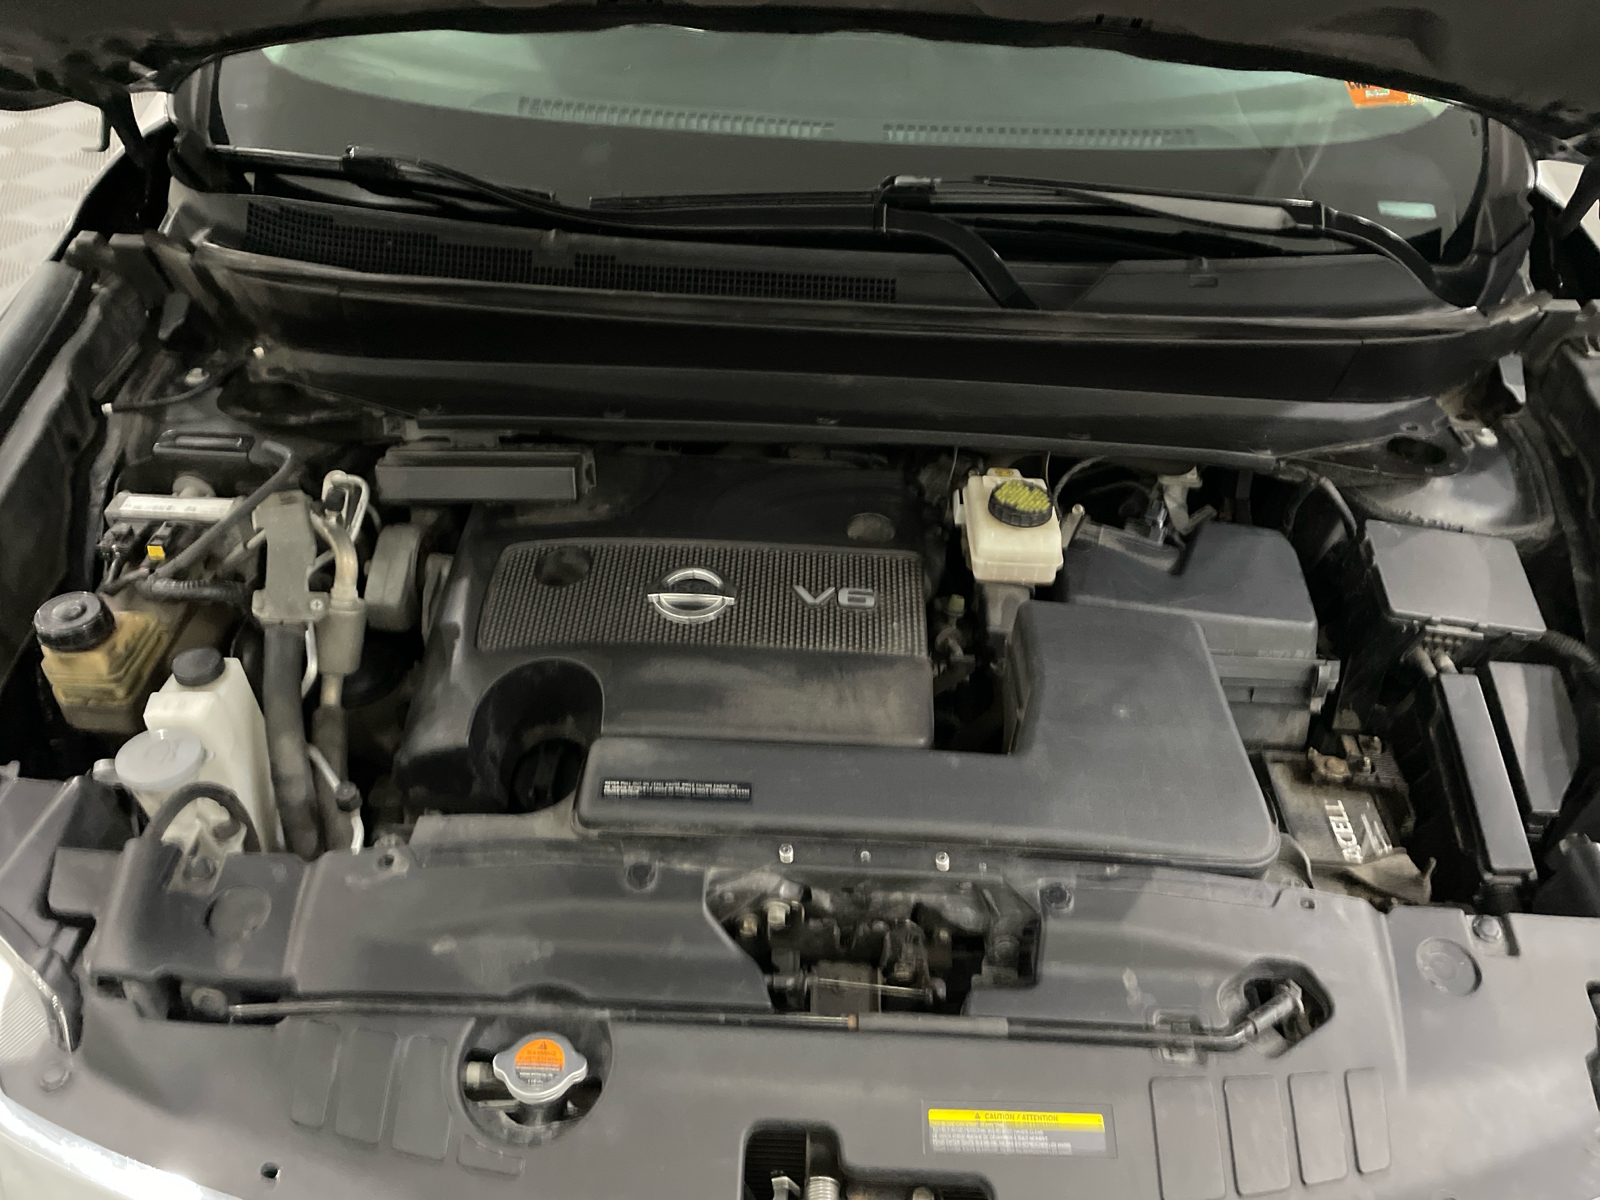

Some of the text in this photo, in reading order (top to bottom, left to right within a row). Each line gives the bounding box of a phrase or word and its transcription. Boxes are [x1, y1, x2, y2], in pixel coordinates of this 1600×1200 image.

[792, 585, 875, 609] V6
[984, 1112, 1015, 1120] CAUTION
[1021, 1113, 1059, 1122] ATTENTION
